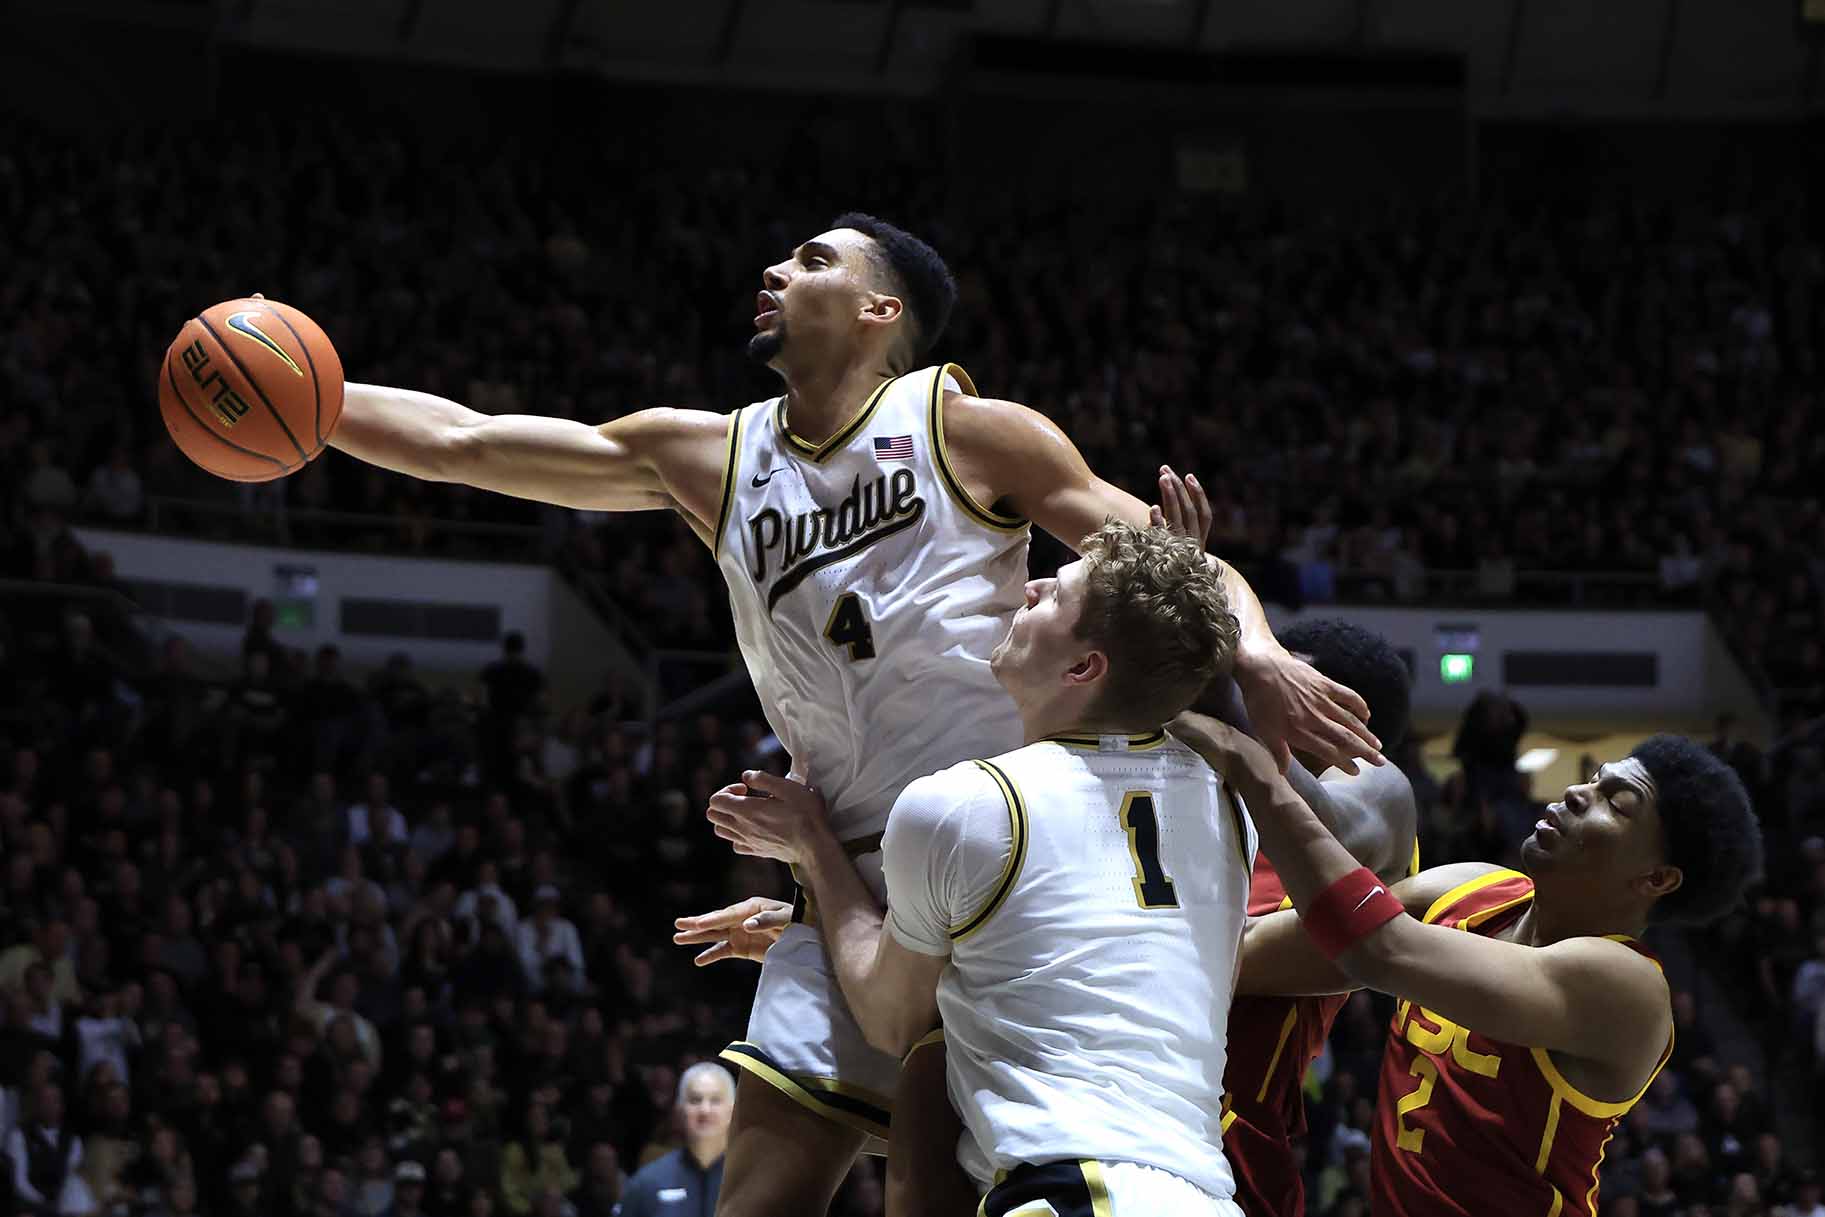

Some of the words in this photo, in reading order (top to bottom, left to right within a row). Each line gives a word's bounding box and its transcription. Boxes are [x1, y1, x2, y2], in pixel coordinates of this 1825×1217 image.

[181, 339, 250, 424] ELITE
[748, 468, 926, 620] Purdue
[823, 590, 876, 661] 4
[1119, 791, 1180, 909] 1
[1397, 999, 1502, 1079] SC
[1396, 1055, 1439, 1153] 2
